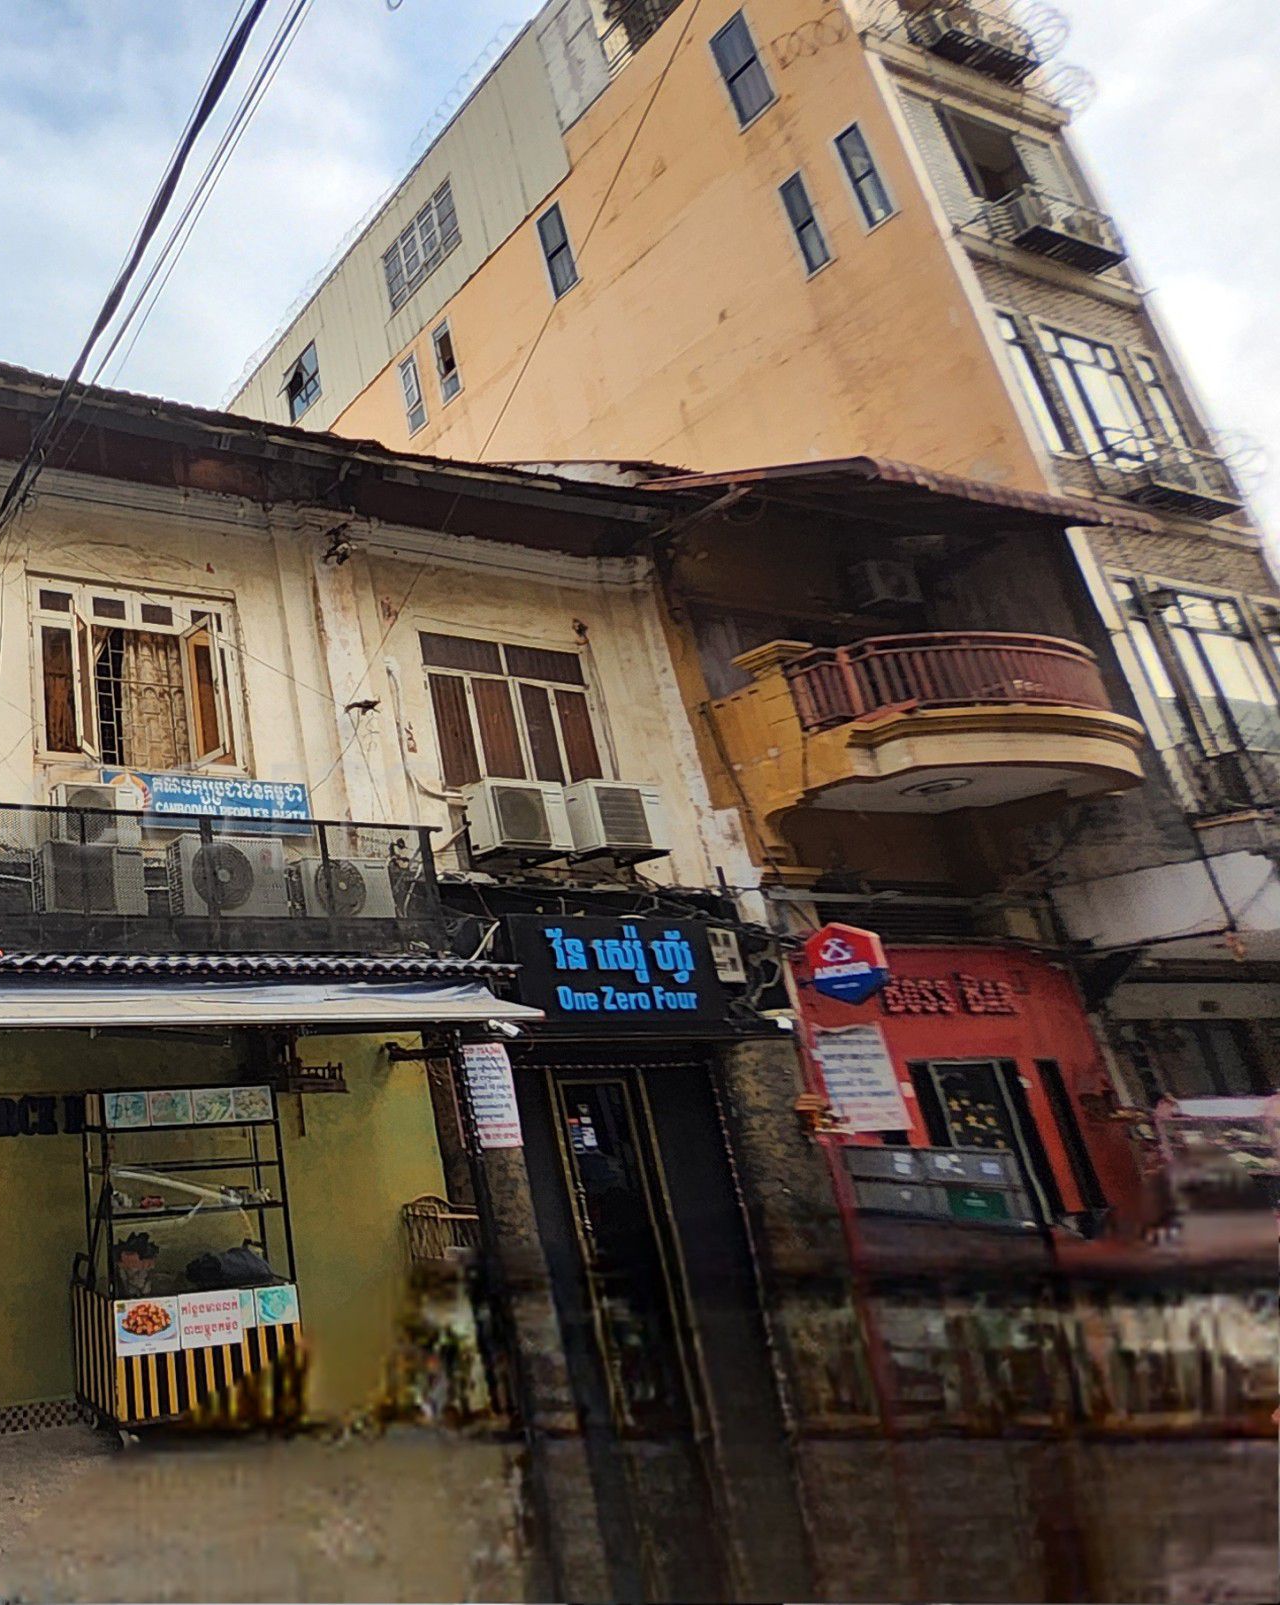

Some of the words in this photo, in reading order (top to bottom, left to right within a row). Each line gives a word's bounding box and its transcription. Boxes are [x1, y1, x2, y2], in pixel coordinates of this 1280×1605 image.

[556, 985, 599, 1011] One
[600, 986, 651, 1011] Zero
[652, 985, 698, 1011] Four
